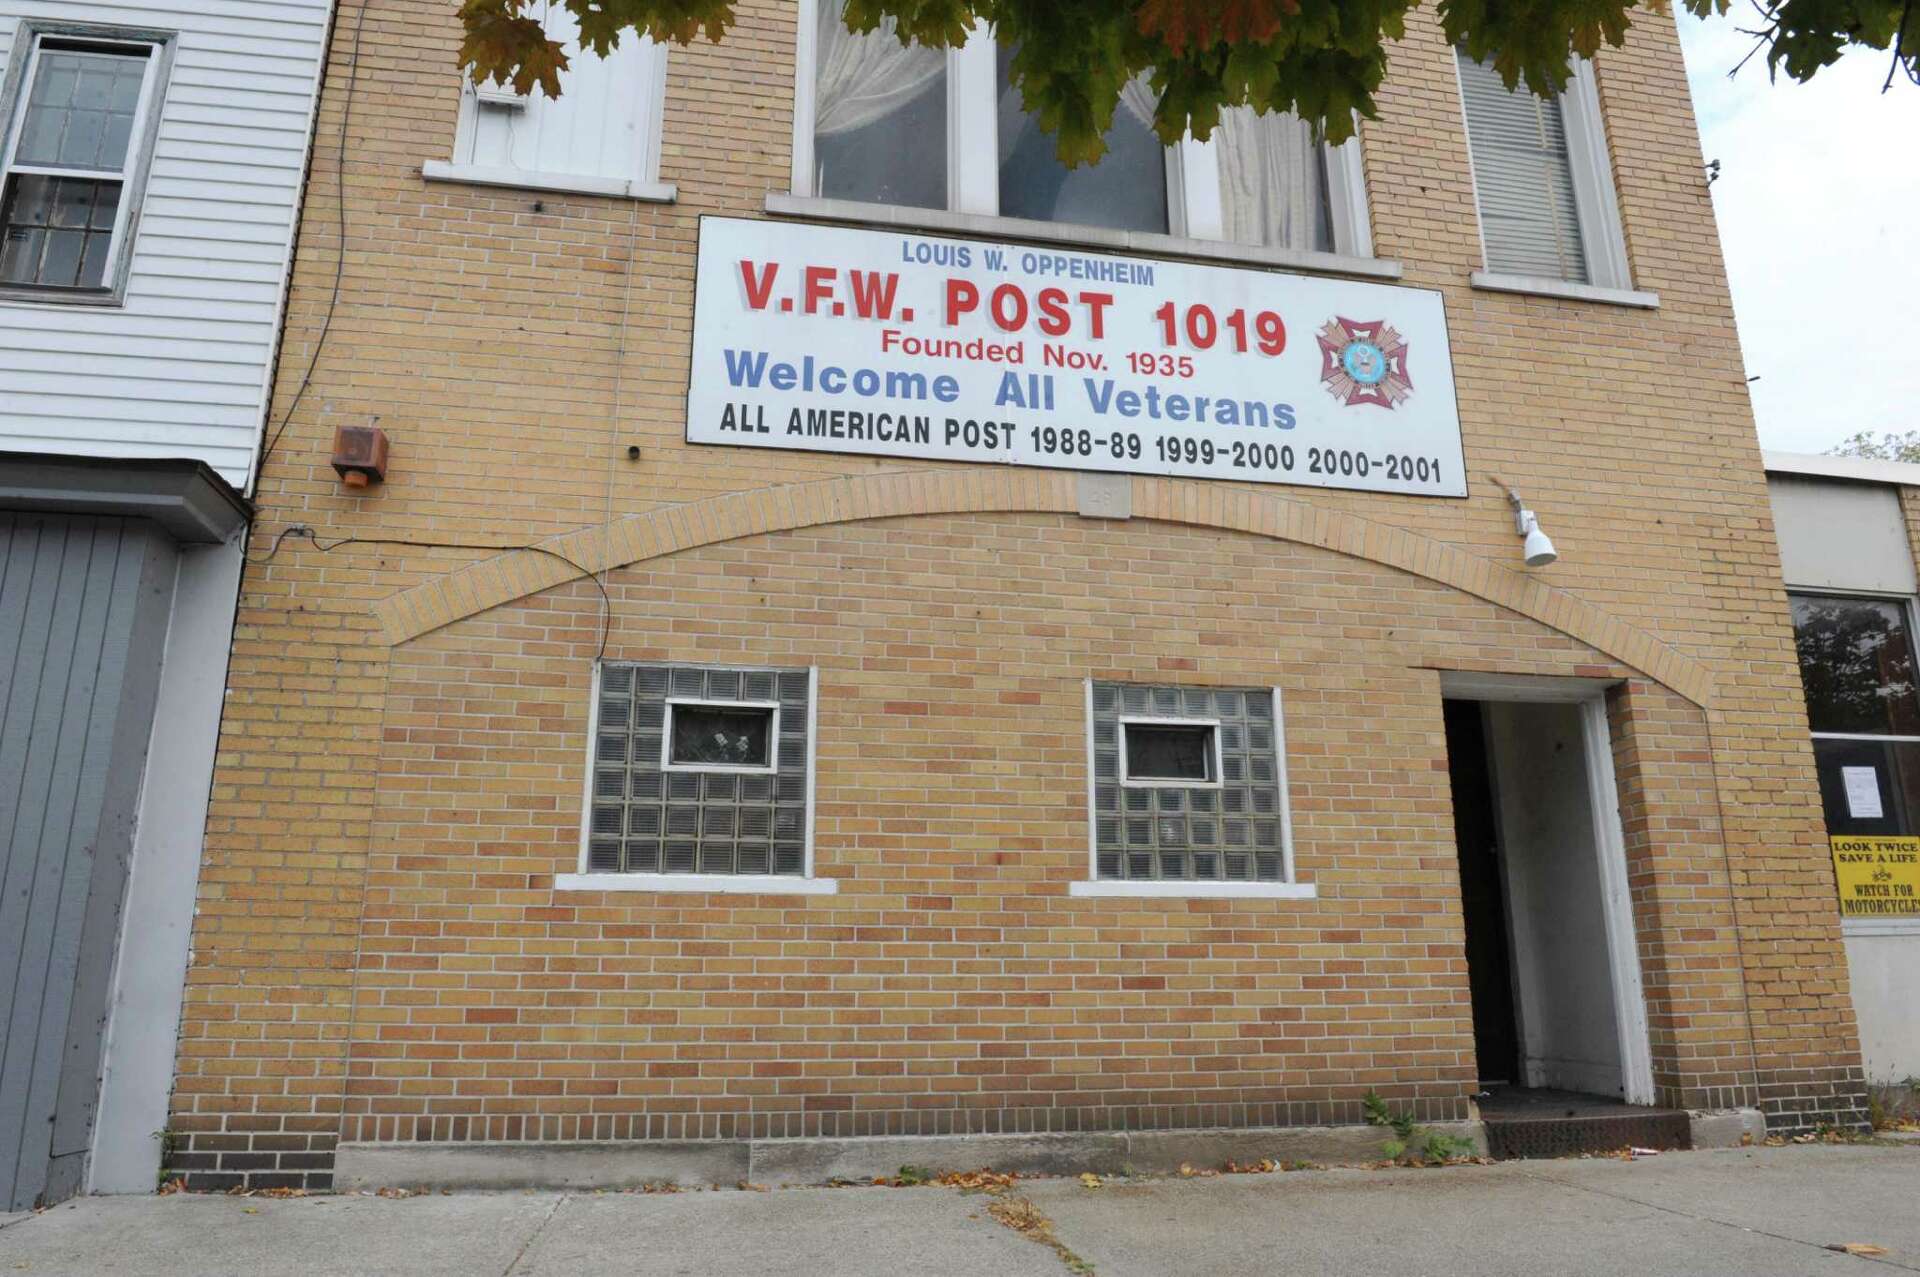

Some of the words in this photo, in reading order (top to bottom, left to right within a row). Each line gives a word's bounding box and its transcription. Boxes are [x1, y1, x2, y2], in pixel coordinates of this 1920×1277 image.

[902, 240, 971, 268] LOUIS
[984, 249, 1008, 271] W.
[1021, 253, 1155, 286] OPPENHEIM
[740, 260, 914, 322] V.F.W.
[946, 279, 1114, 339] POST
[1156, 301, 1287, 356] 1019
[882, 329, 1024, 364] Founded
[1043, 343, 1108, 371] Nov.
[1126, 352, 1195, 378] 1935
[724, 349, 960, 402] Welcome
[995, 371, 1054, 411] All
[1083, 378, 1297, 430] Veterans
[719, 403, 770, 434] ALL
[786, 407, 930, 444] AMERICAN
[945, 418, 1016, 450] POST
[1031, 426, 1141, 460] 1988-89
[1155, 435, 1295, 471] 1999-2000
[1308, 447, 1441, 483] 2000-2001
[1834, 842, 1872, 851] LOOK
[1875, 843, 1918, 852] TWICE
[1839, 854, 1873, 863] SAVE
[1877, 854, 1886, 862] A
[1889, 854, 1918, 863] LIFE
[1854, 884, 1890, 897] WATCH
[1893, 884, 1914, 897] FOR
